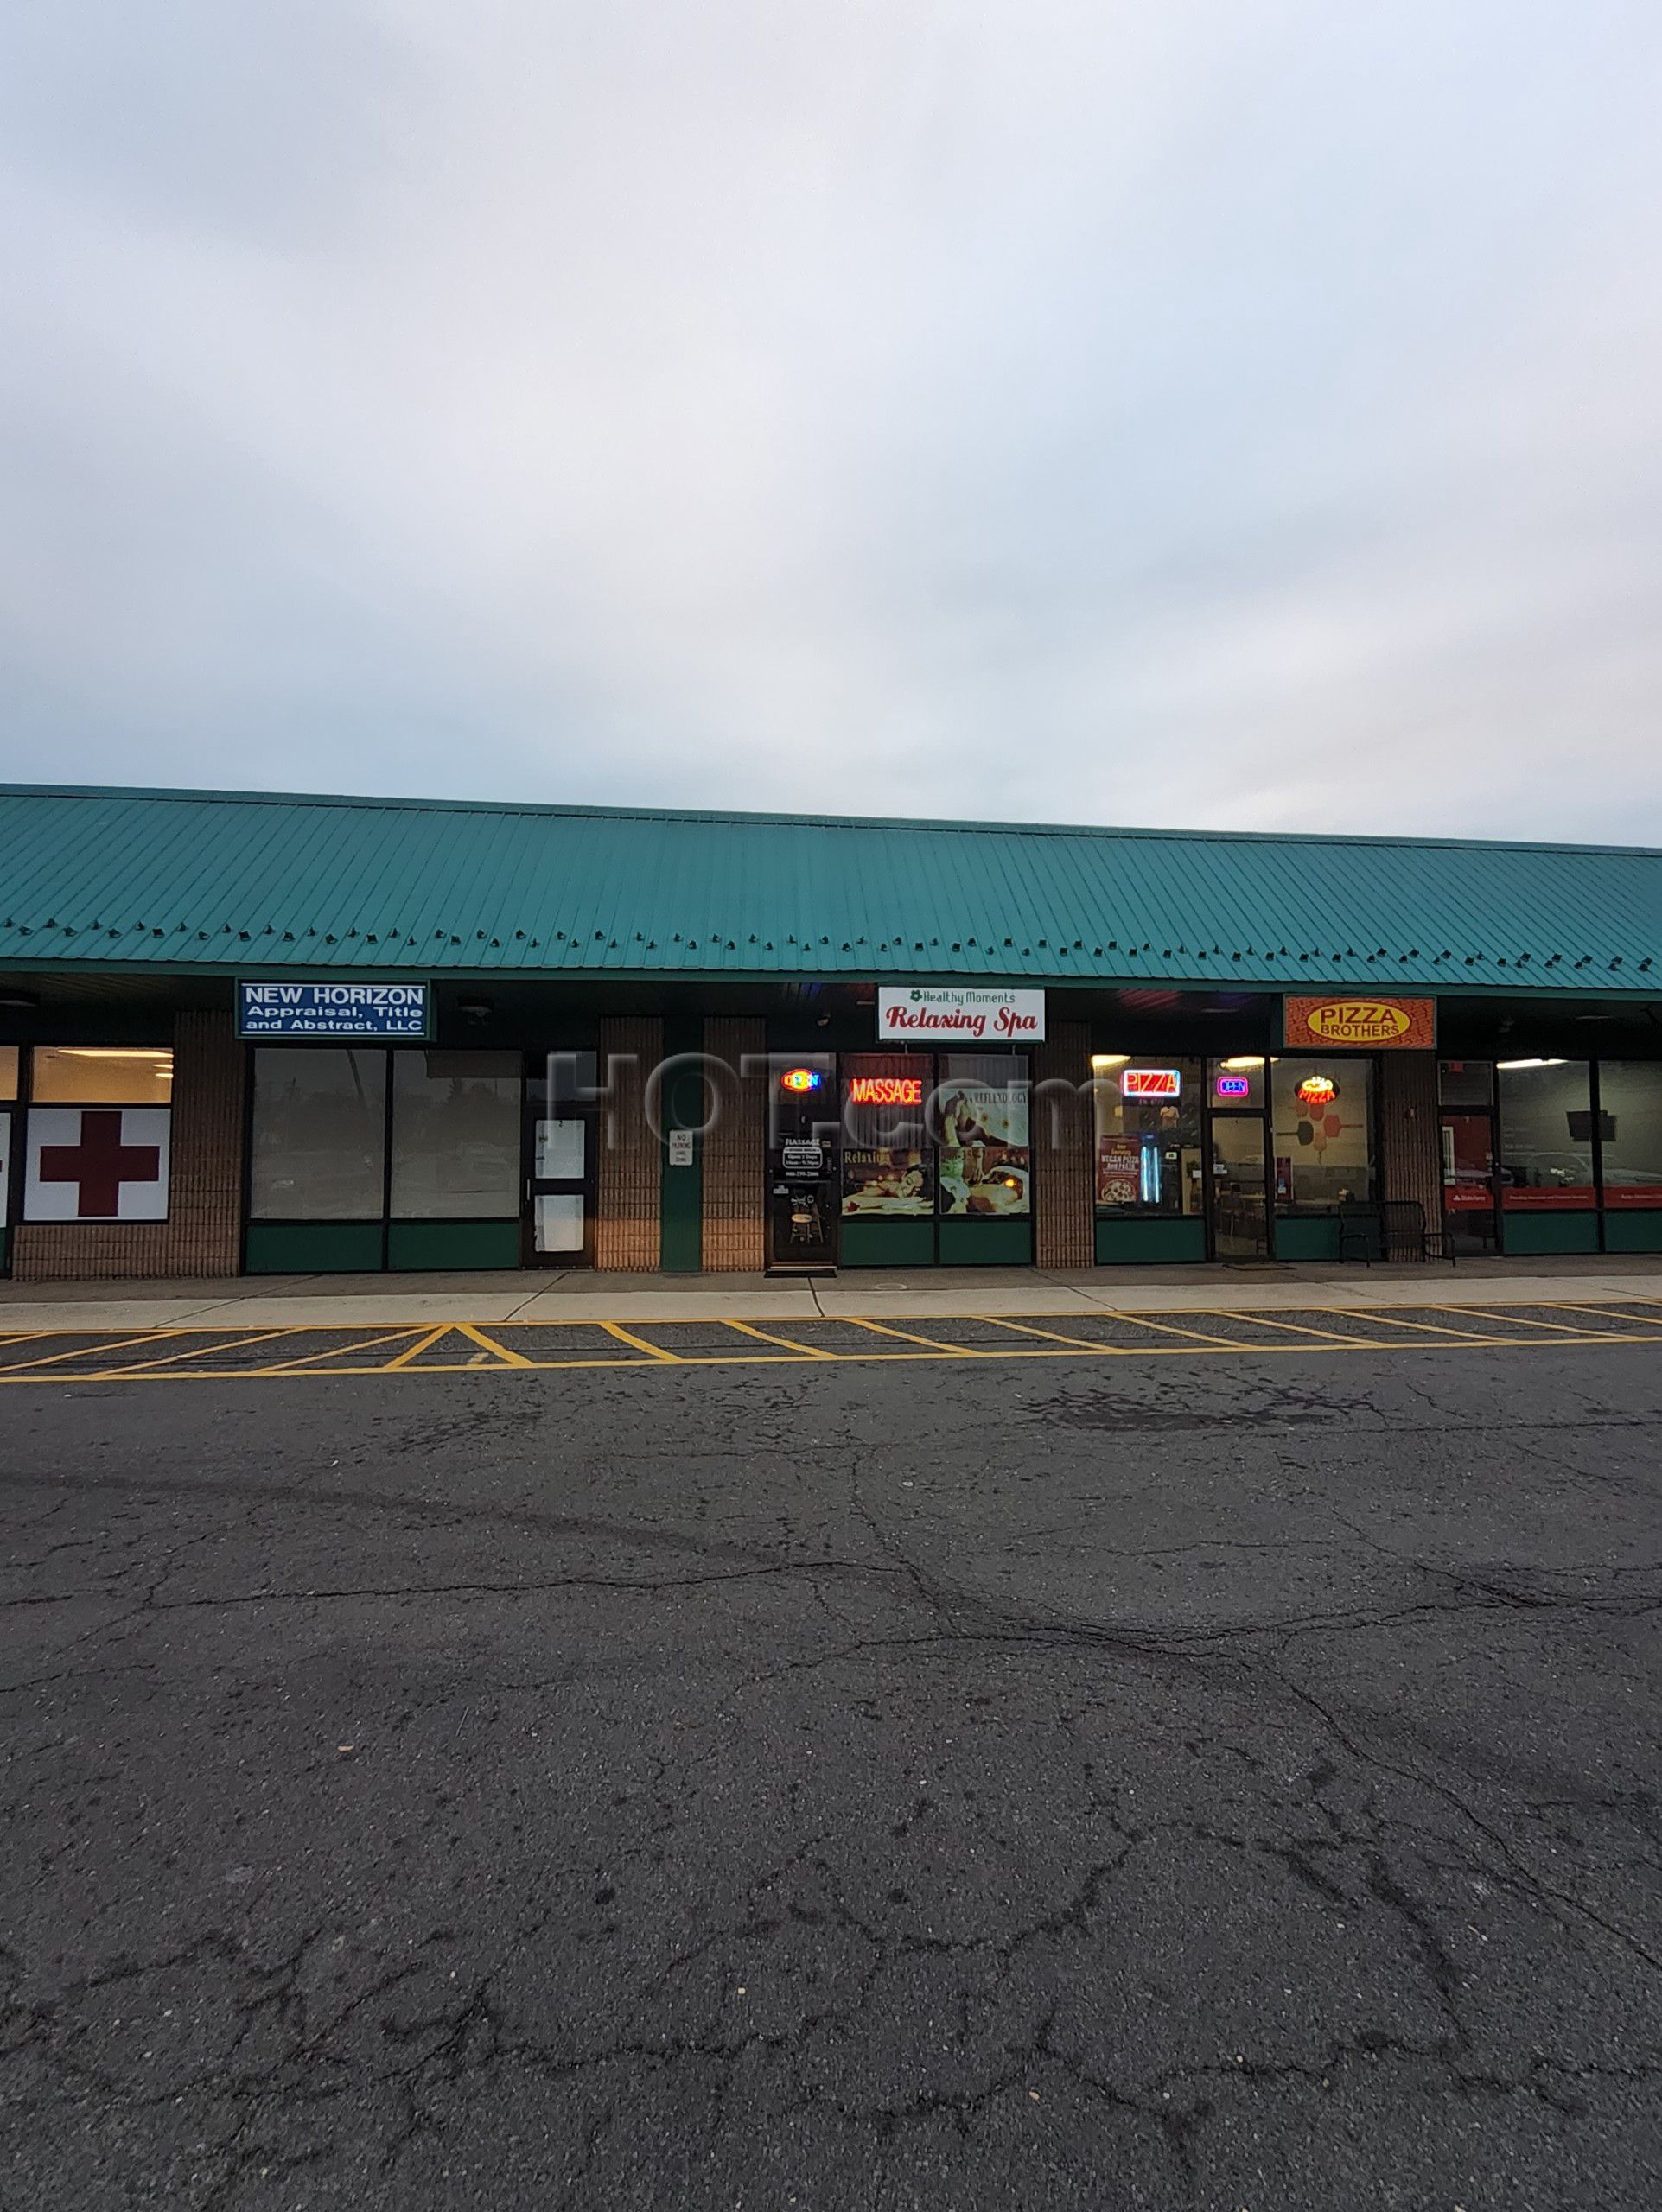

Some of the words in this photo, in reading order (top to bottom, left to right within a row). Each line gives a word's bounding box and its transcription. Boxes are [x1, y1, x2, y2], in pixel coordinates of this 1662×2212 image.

[245, 987, 302, 1003] NEW
[313, 988, 423, 1005] HORIZON
[923, 991, 965, 1006] Healthy
[965, 991, 1016, 1003] Moments
[247, 1005, 363, 1018] Appraisal,
[373, 1007, 423, 1017] Title
[1321, 1007, 1398, 1024] PIZZA
[245, 1020, 282, 1029] and
[290, 1020, 379, 1032] Abstract,
[386, 1020, 422, 1030] LLC
[886, 1005, 986, 1037] Relaxing
[994, 1007, 1038, 1037] Spa
[1321, 1025, 1399, 1037] BROTHERS
[783, 1074, 820, 1088] OPEN
[1126, 1073, 1178, 1093] PIZZA
[1221, 1080, 1245, 1093] OPEN
[851, 1077, 923, 1104] MASSAGE
[974, 1091, 1026, 1104] REFLEXOLOGY
[1298, 1088, 1336, 1104] PIZZA
